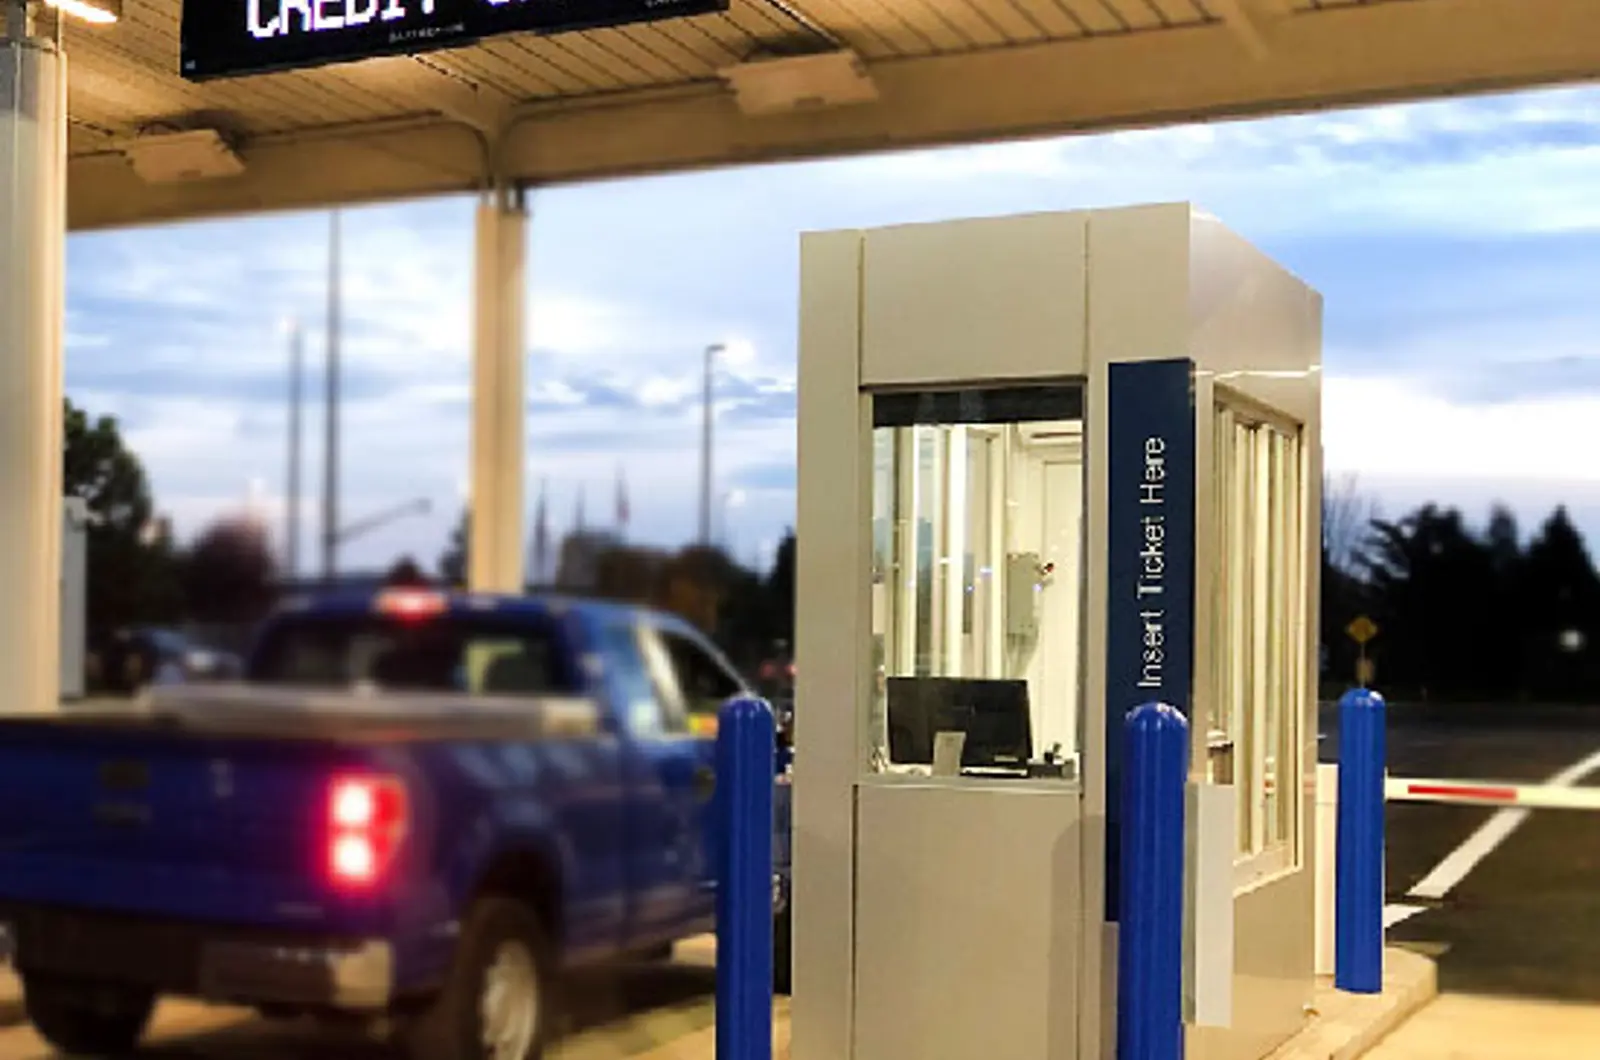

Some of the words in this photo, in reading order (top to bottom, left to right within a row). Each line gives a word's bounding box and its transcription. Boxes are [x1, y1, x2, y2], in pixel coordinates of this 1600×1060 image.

[247, 0, 434, 38] CRE
[1139, 436, 1166, 504] Here
[1136, 515, 1165, 600] Ticket
[1136, 609, 1164, 688] Insert
